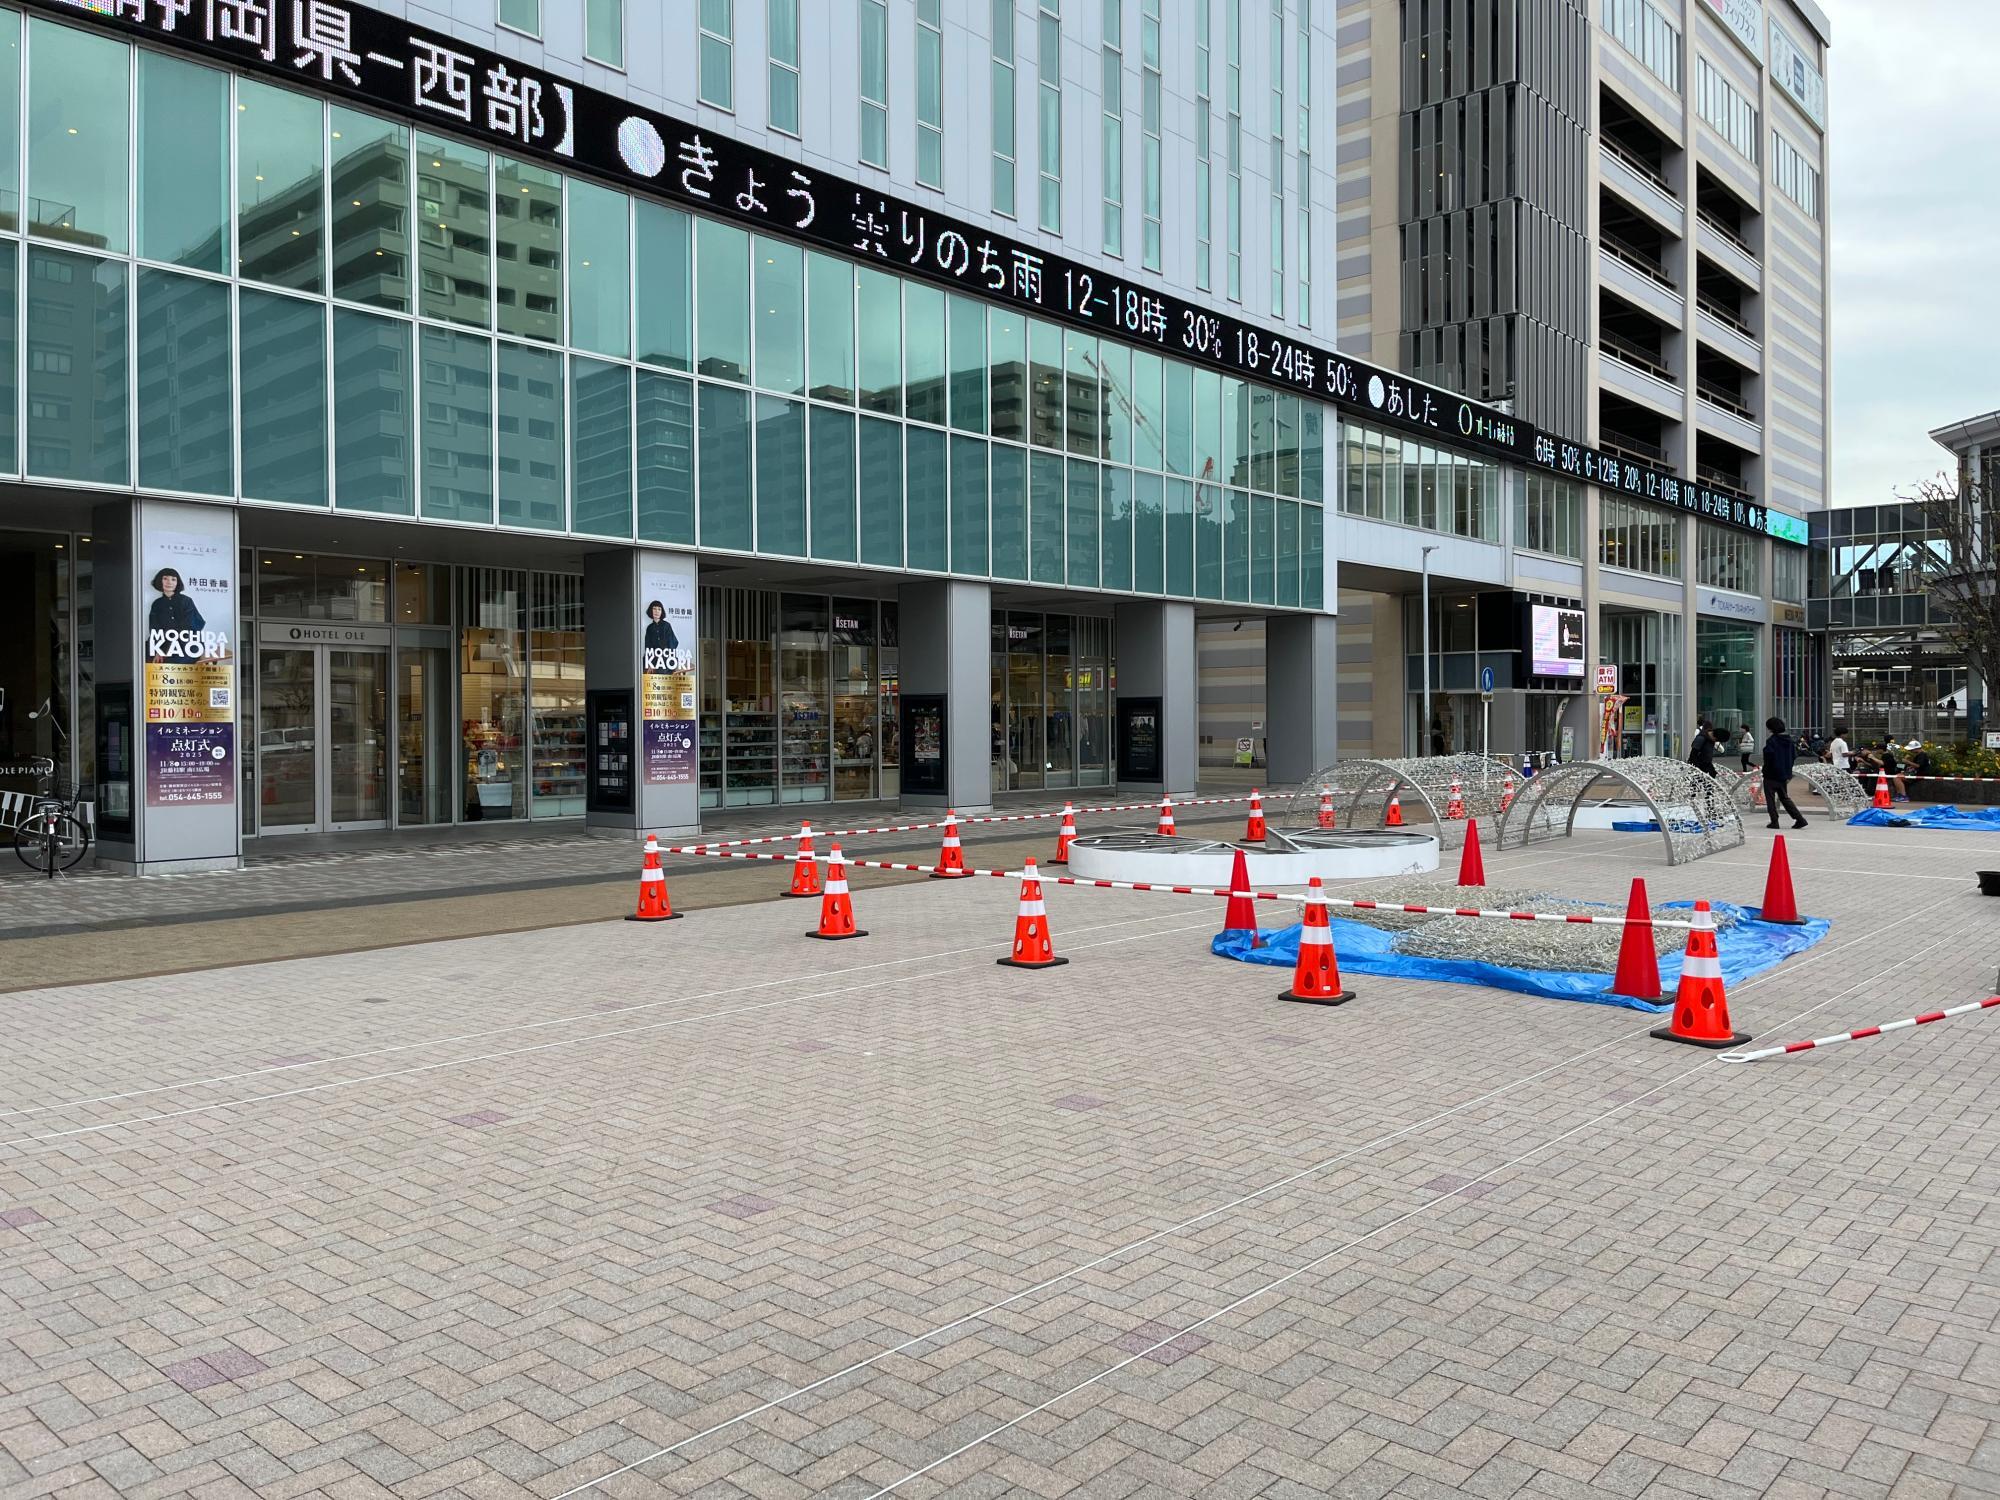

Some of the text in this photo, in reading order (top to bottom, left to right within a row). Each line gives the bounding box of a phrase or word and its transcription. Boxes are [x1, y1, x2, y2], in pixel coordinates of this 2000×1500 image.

[678, 135, 815, 228] きょう
[1064, 269, 1168, 342] 12-18時
[1236, 328, 1316, 389] 18-24時
[1387, 379, 1438, 427] あした
[188, 577, 228, 588] 持田香織
[150, 628, 229, 644] MOCHIDA
[303, 629, 366, 640] HOTEL OLE
[149, 639, 226, 659] KAORI
[645, 647, 693, 659] MOCHIDA
[644, 657, 691, 670] KAORI
[1598, 675, 1614, 684] ATM
[157, 726, 224, 736] イルミネーション
[650, 722, 691, 730] イルミネーション
[657, 732, 682, 743] 点灯式
[170, 738, 211, 752] 点灯式
[18, 766, 52, 775] PIANO
